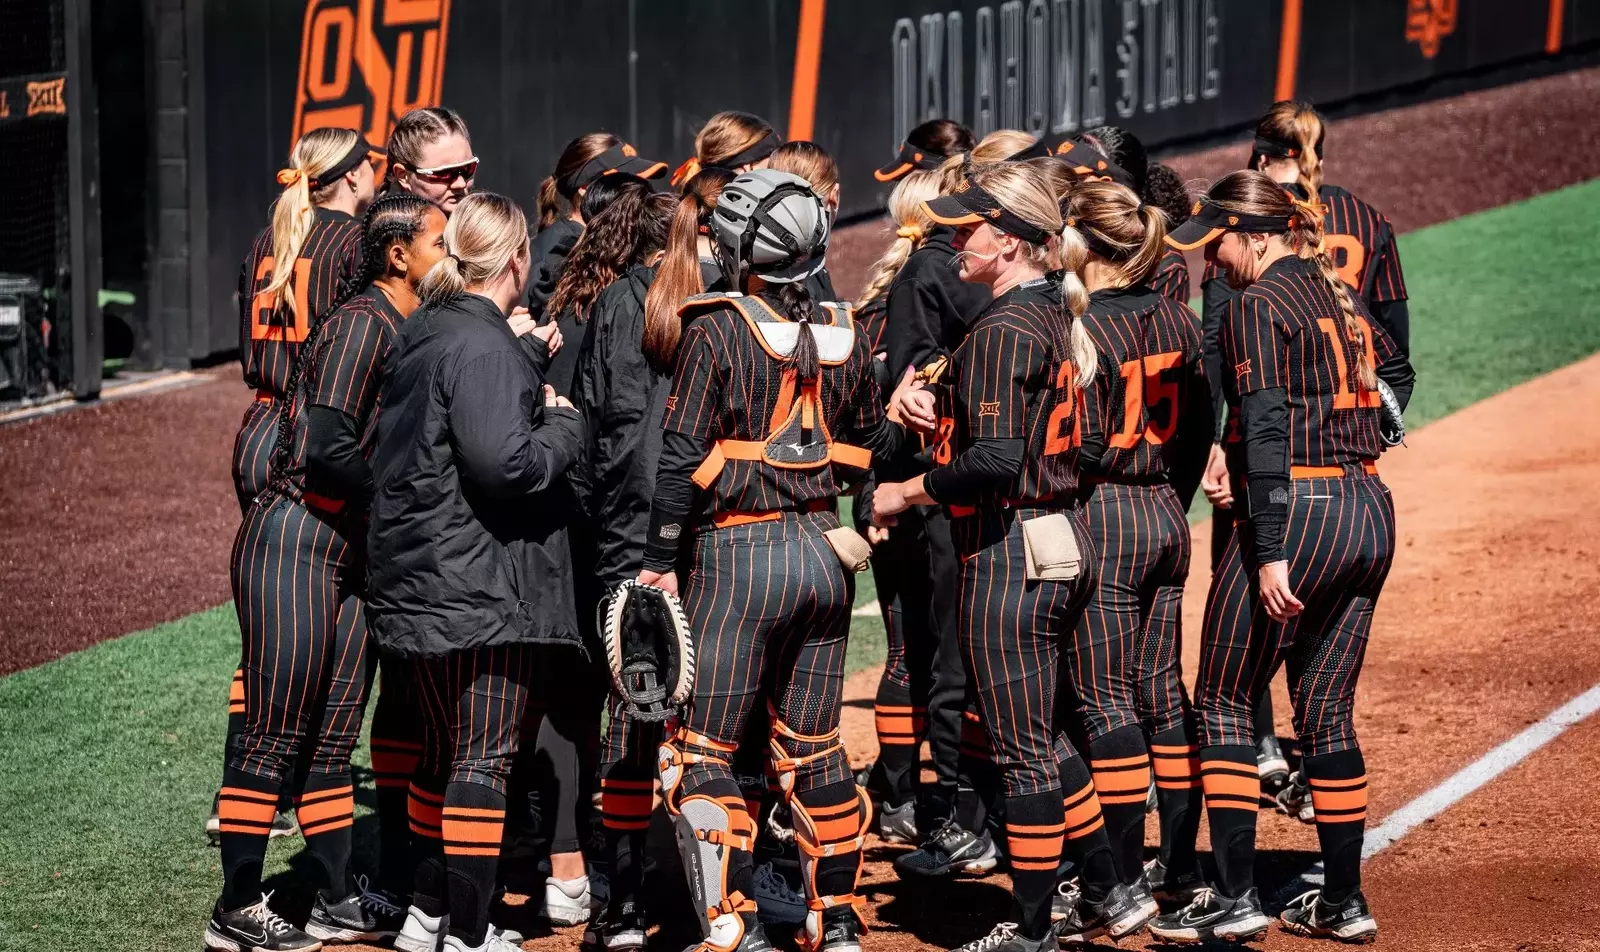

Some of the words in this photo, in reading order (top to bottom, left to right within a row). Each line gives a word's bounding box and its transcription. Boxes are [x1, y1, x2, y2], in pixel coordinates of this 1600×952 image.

[892, 0, 1106, 159] OKLAHOMA
[1116, 0, 1222, 118] STATE
[1109, 351, 1182, 449] 15
